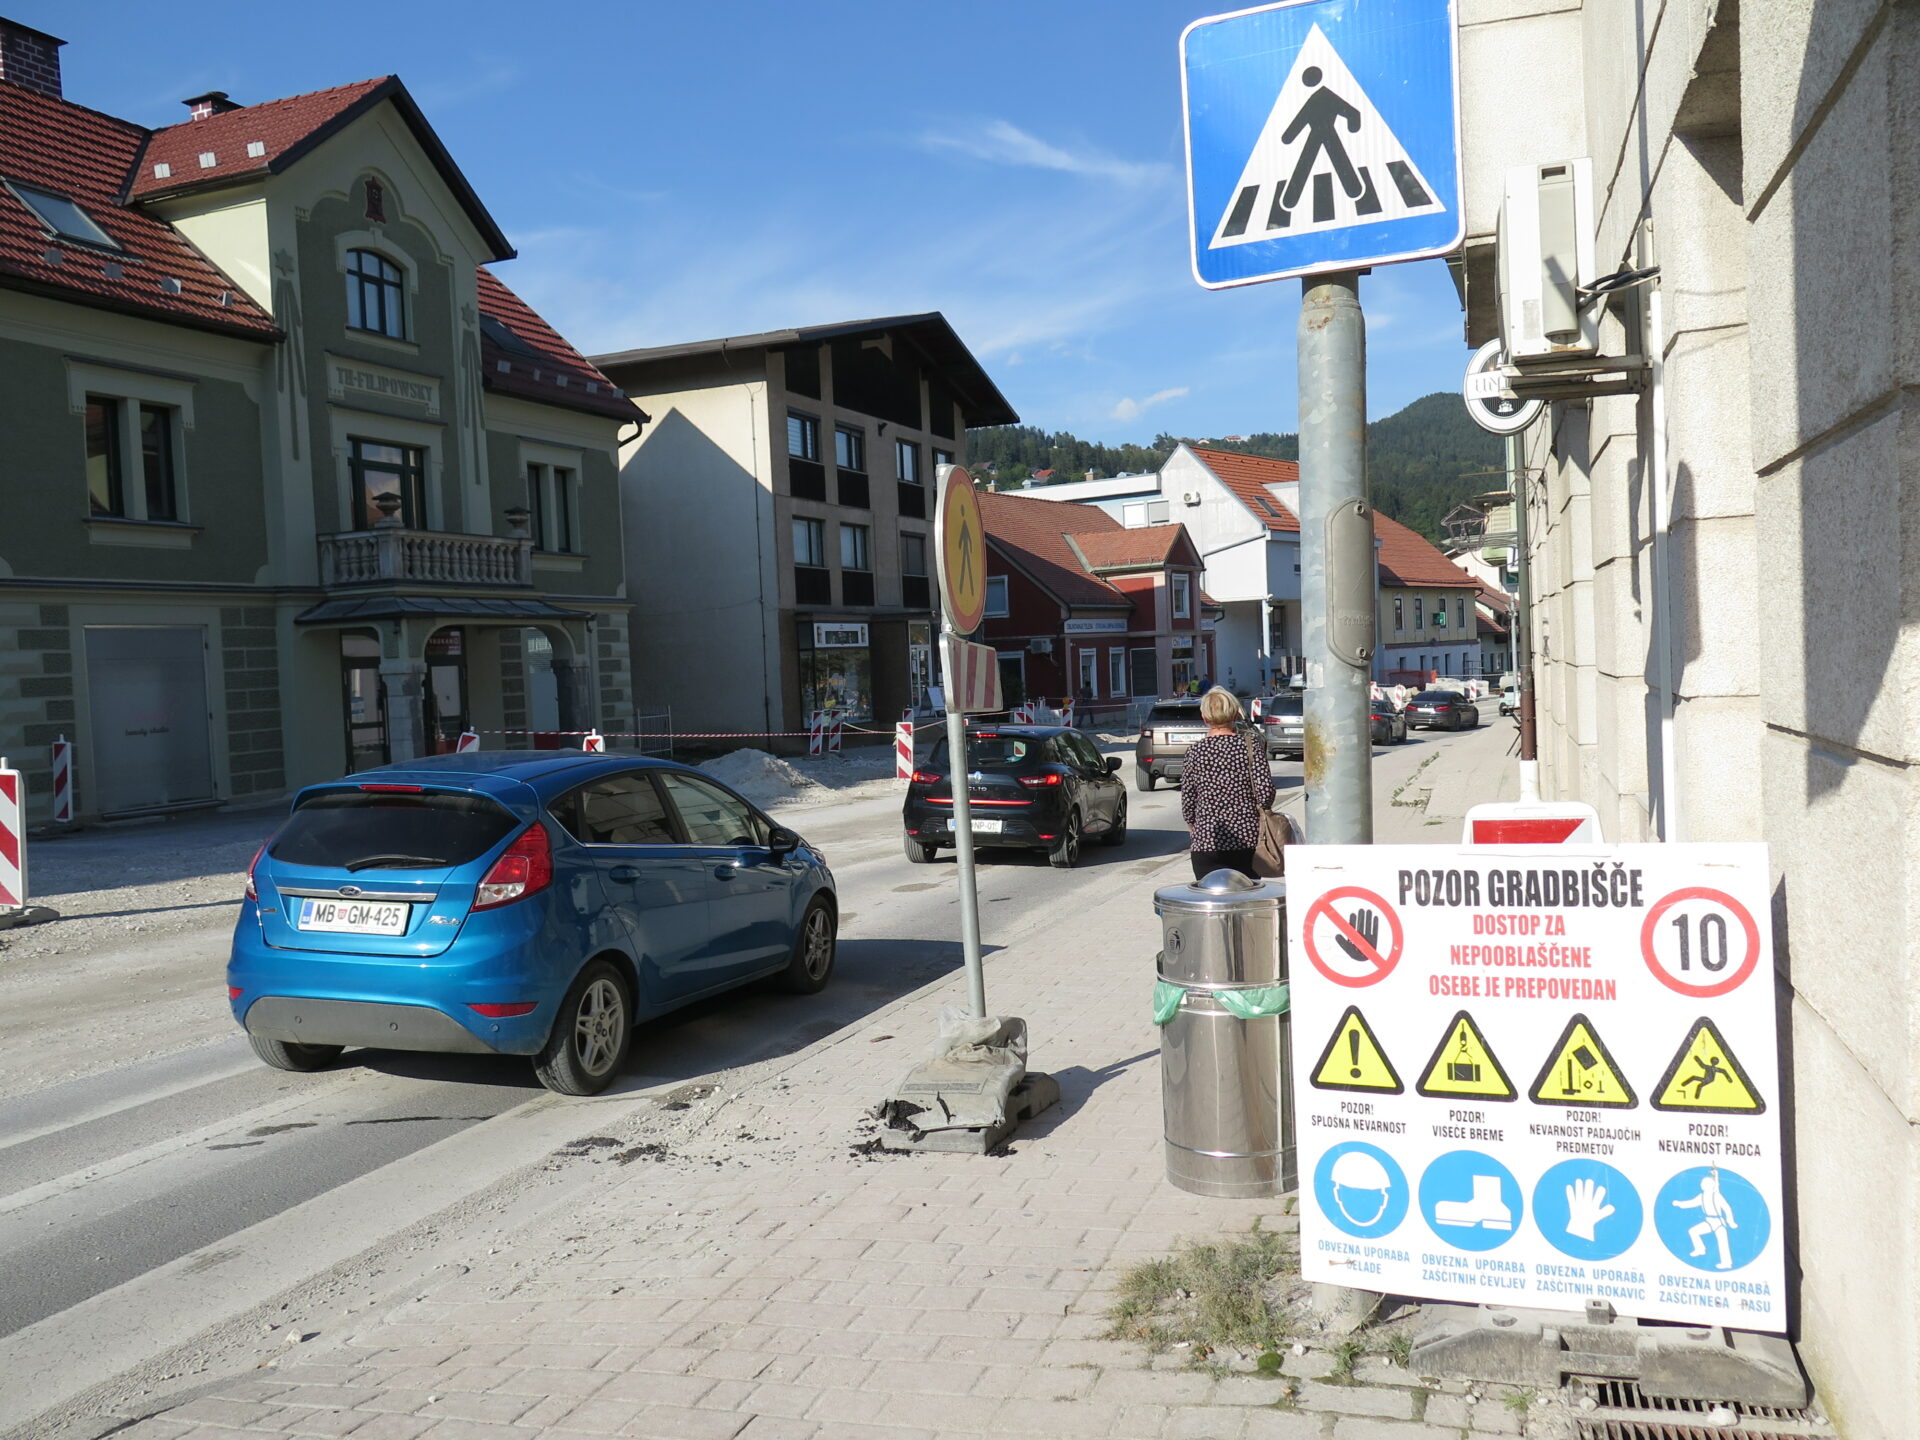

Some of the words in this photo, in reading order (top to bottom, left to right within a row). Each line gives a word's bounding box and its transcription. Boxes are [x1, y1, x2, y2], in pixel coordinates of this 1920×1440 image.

[1399, 869, 1480, 907] POZOR
[1487, 862, 1644, 908] GRADBIŠČE
[314, 903, 336, 923] MB
[347, 905, 401, 927] GM-425
[1473, 914, 1541, 936] DOSTOP
[1544, 915, 1566, 936] ZA
[1671, 913, 1728, 972] 10
[1450, 942, 1592, 969] NEPOOBLAŠČENE
[1429, 975, 1480, 997] OSEBE
[1484, 977, 1500, 998] JE
[1504, 978, 1617, 1000] PREPOVEDAN
[1341, 1101, 1374, 1115] POZOR!
[1449, 1109, 1485, 1124] POZOR!
[1566, 1110, 1601, 1123] POZOR!
[1311, 1114, 1350, 1129] SPLOŠNA
[1353, 1119, 1407, 1134] NEVARNOST
[1432, 1124, 1466, 1139] VISEČE
[1470, 1127, 1504, 1142] BREME
[1529, 1123, 1584, 1138] NEVARNOST
[1688, 1123, 1729, 1138] POZOR!
[1556, 1141, 1615, 1155] PREDMETOV
[1658, 1139, 1721, 1156] NEVARNOST
[1725, 1143, 1762, 1157] PADCA
[1318, 1239, 1361, 1256] OBVEZNA
[1364, 1246, 1411, 1263] UPORABA
[1422, 1253, 1469, 1269] OBVEZNA
[1475, 1258, 1526, 1274] UPORABA
[1535, 1263, 1586, 1279] OBVEZNA
[1592, 1268, 1646, 1285] UPORABA
[1422, 1268, 1476, 1285] ZAŠČITNIH
[1480, 1274, 1526, 1290] ČEVLJEV
[1536, 1278, 1593, 1296] ZAŠČITNIH
[1597, 1284, 1646, 1300] ROKAVIC
[1659, 1274, 1711, 1291] OBVEZNA
[1715, 1281, 1771, 1297] UPORABA
[1740, 1298, 1771, 1313] PASU
